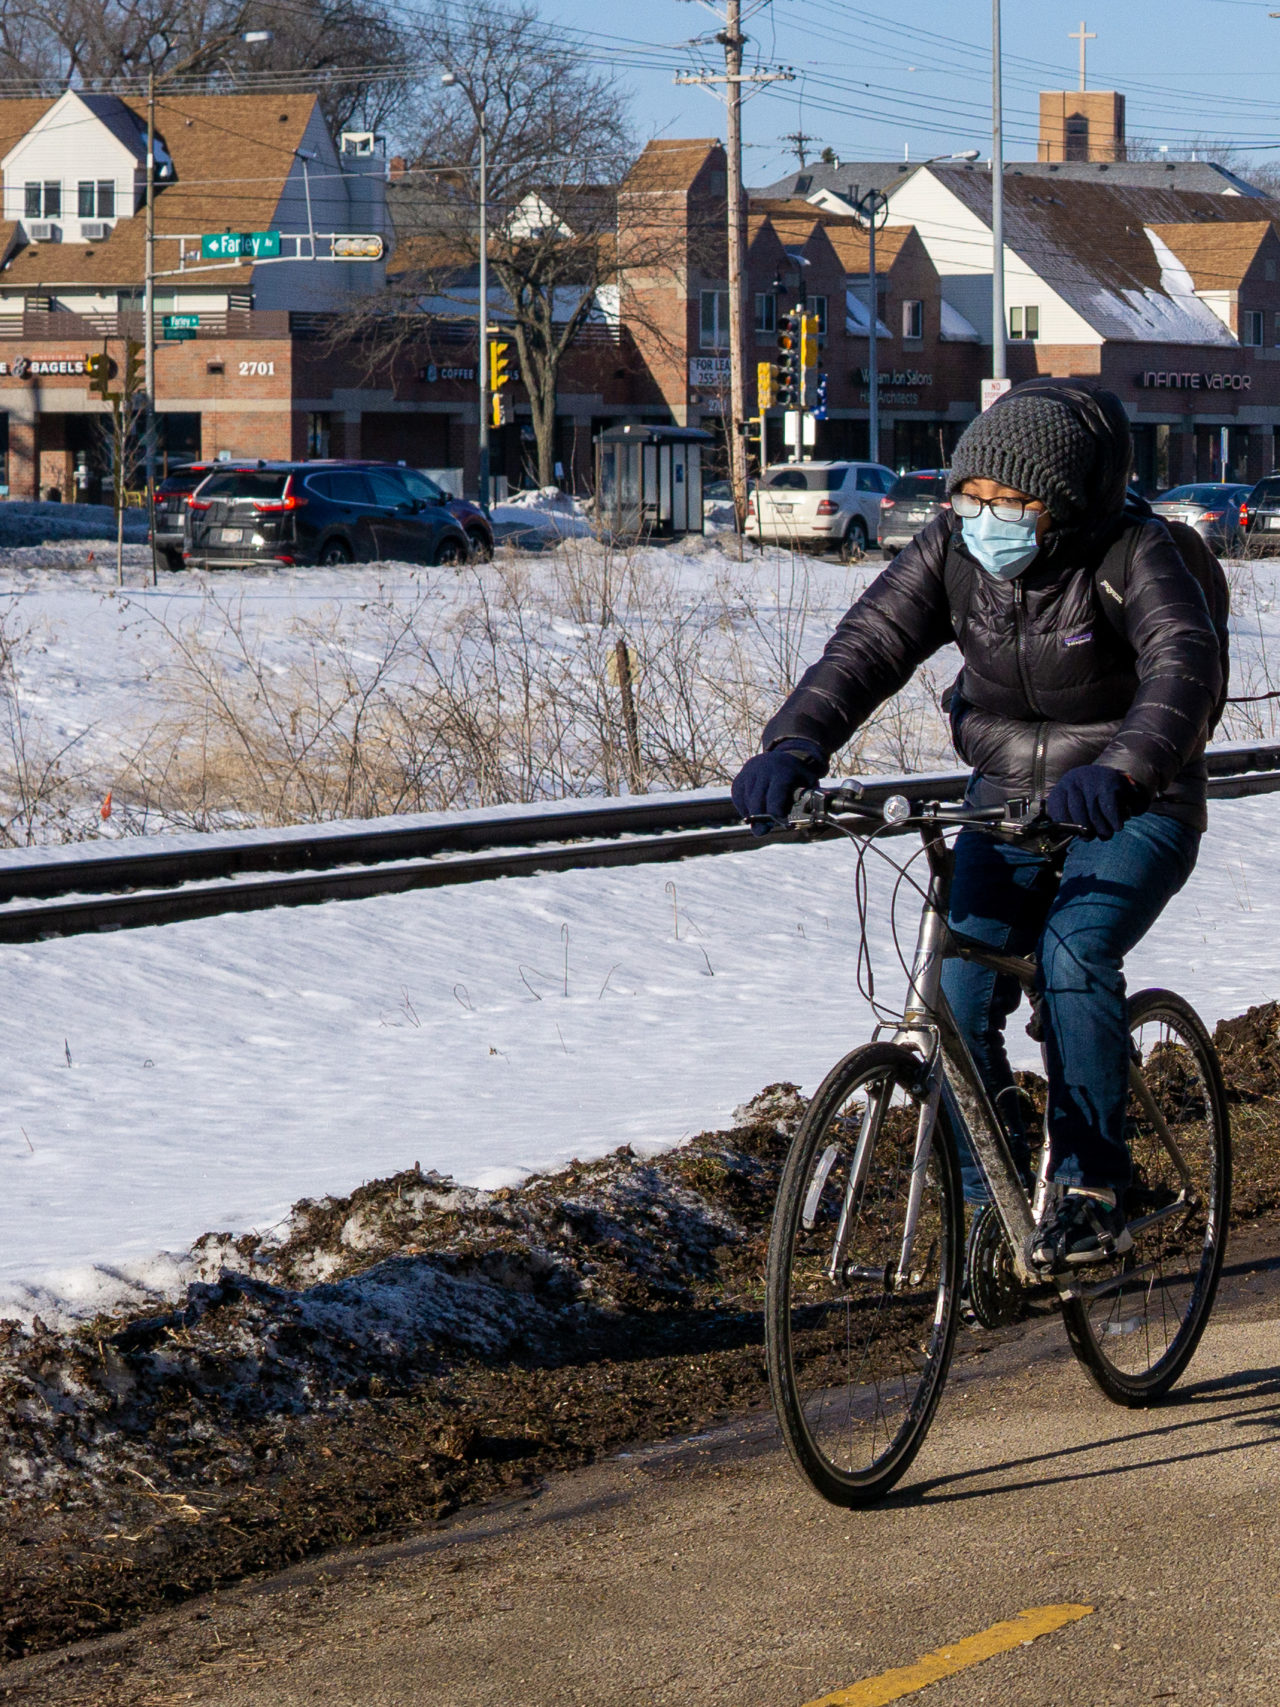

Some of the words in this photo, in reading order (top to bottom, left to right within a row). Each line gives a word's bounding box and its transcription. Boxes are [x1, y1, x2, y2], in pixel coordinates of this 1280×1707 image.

[221, 236, 260, 256] Farley
[31, 362, 84, 373] BAGELS
[239, 361, 275, 376] 2701
[696, 359, 713, 370] FOR
[440, 368, 474, 380] COFFEE
[891, 369, 905, 384] Jon
[907, 369, 933, 385] Salons
[1144, 371, 1200, 389] INFINITE
[991, 382, 1001, 391] NO
